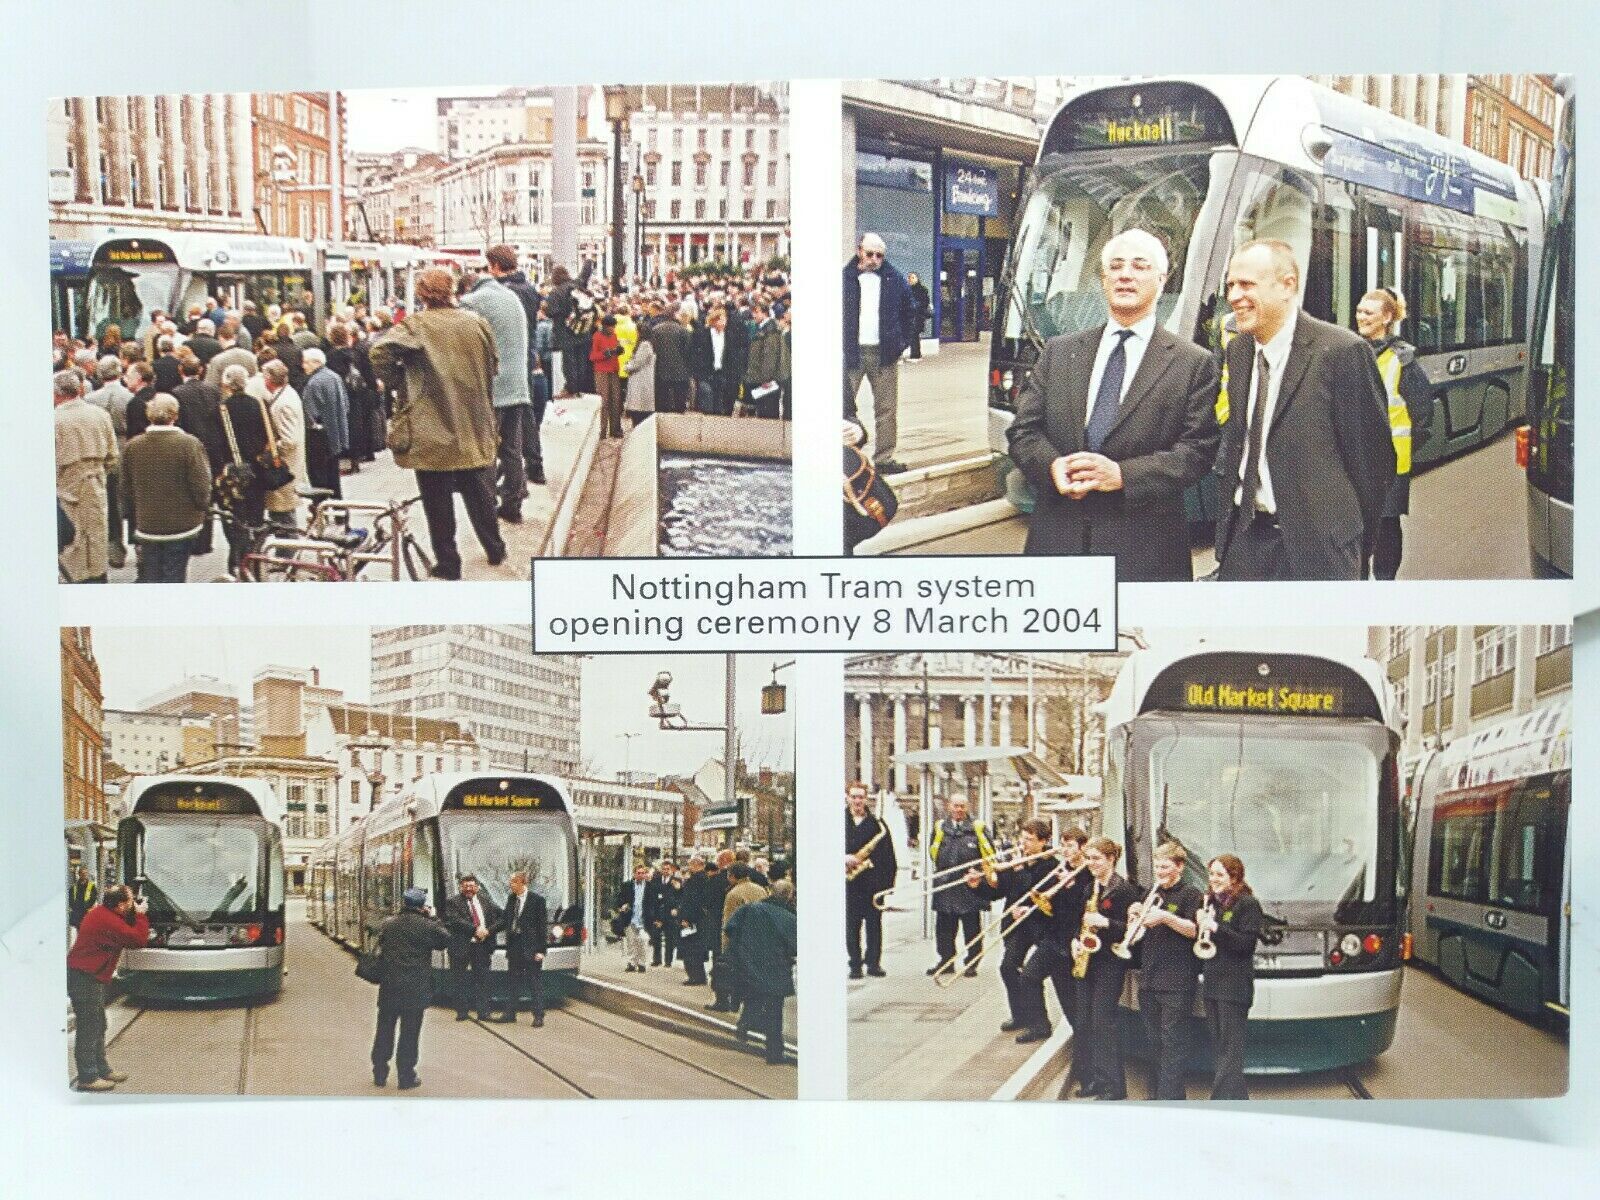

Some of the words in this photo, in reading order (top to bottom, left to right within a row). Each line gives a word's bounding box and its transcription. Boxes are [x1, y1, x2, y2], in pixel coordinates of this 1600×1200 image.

[1108, 114, 1173, 142] Hucknall
[612, 573, 807, 607] Nottingham
[820, 572, 902, 599] Tram
[917, 575, 1035, 605] system
[549, 609, 683, 642] opening
[697, 613, 861, 641] ceremony
[873, 608, 891, 634] 8
[905, 607, 1008, 634] March
[1022, 607, 1102, 634] 2004
[1186, 683, 1215, 706] Old
[1217, 683, 1274, 709] Market
[1279, 686, 1334, 712] Square
